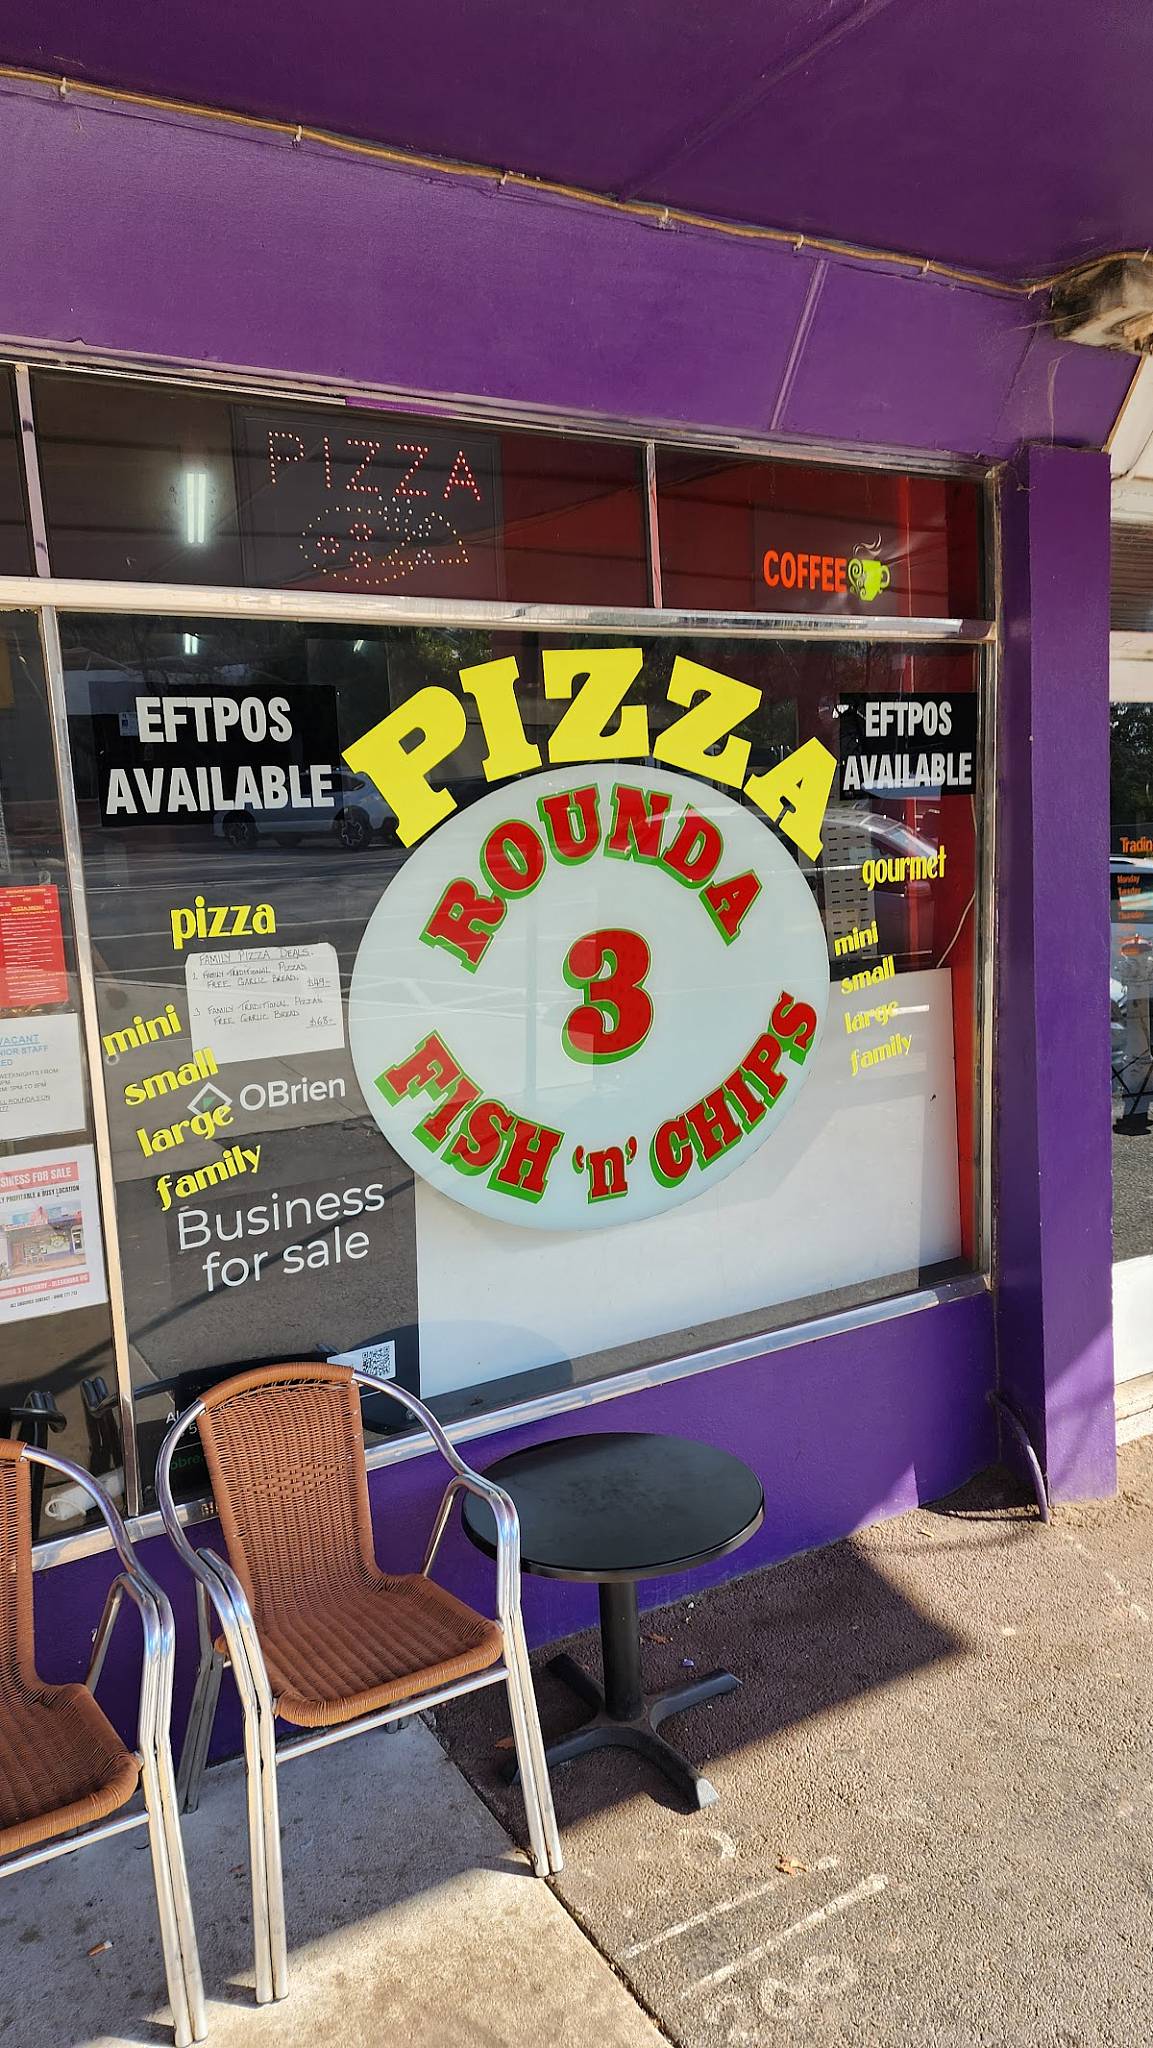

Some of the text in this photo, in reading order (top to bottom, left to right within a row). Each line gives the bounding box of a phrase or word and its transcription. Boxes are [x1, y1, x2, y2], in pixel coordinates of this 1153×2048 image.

[268, 430, 482, 502] PIZZA
[763, 550, 848, 593] COFFEE
[135, 696, 293, 743] EFTPOS
[864, 701, 952, 737] EFTPOS
[341, 648, 837, 861] PIZZA
[843, 752, 972, 791] AVAILABLE
[106, 765, 335, 815] AVAILABLE
[420, 782, 762, 973] ROUNDA
[861, 845, 946, 891] gourmet
[170, 896, 276, 950] pizza
[833, 921, 879, 957] mini
[199, 951, 231, 965] FAMILY
[238, 948, 270, 961] PIZZA
[840, 955, 896, 994] small
[562, 928, 653, 1065] 3
[102, 1003, 182, 1057] mini
[849, 1032, 913, 1077] family
[124, 1047, 219, 1105] small
[240, 1077, 346, 1111] OBrien
[374, 1029, 565, 1203] FISH
[649, 991, 817, 1188] CHIPS
[136, 1104, 234, 1158] large
[32, 1170, 49, 1183] FOR
[50, 1167, 72, 1179] SALE
[155, 1144, 261, 1212] family
[177, 1182, 385, 1251] Business
[201, 1225, 369, 1292] for sale
